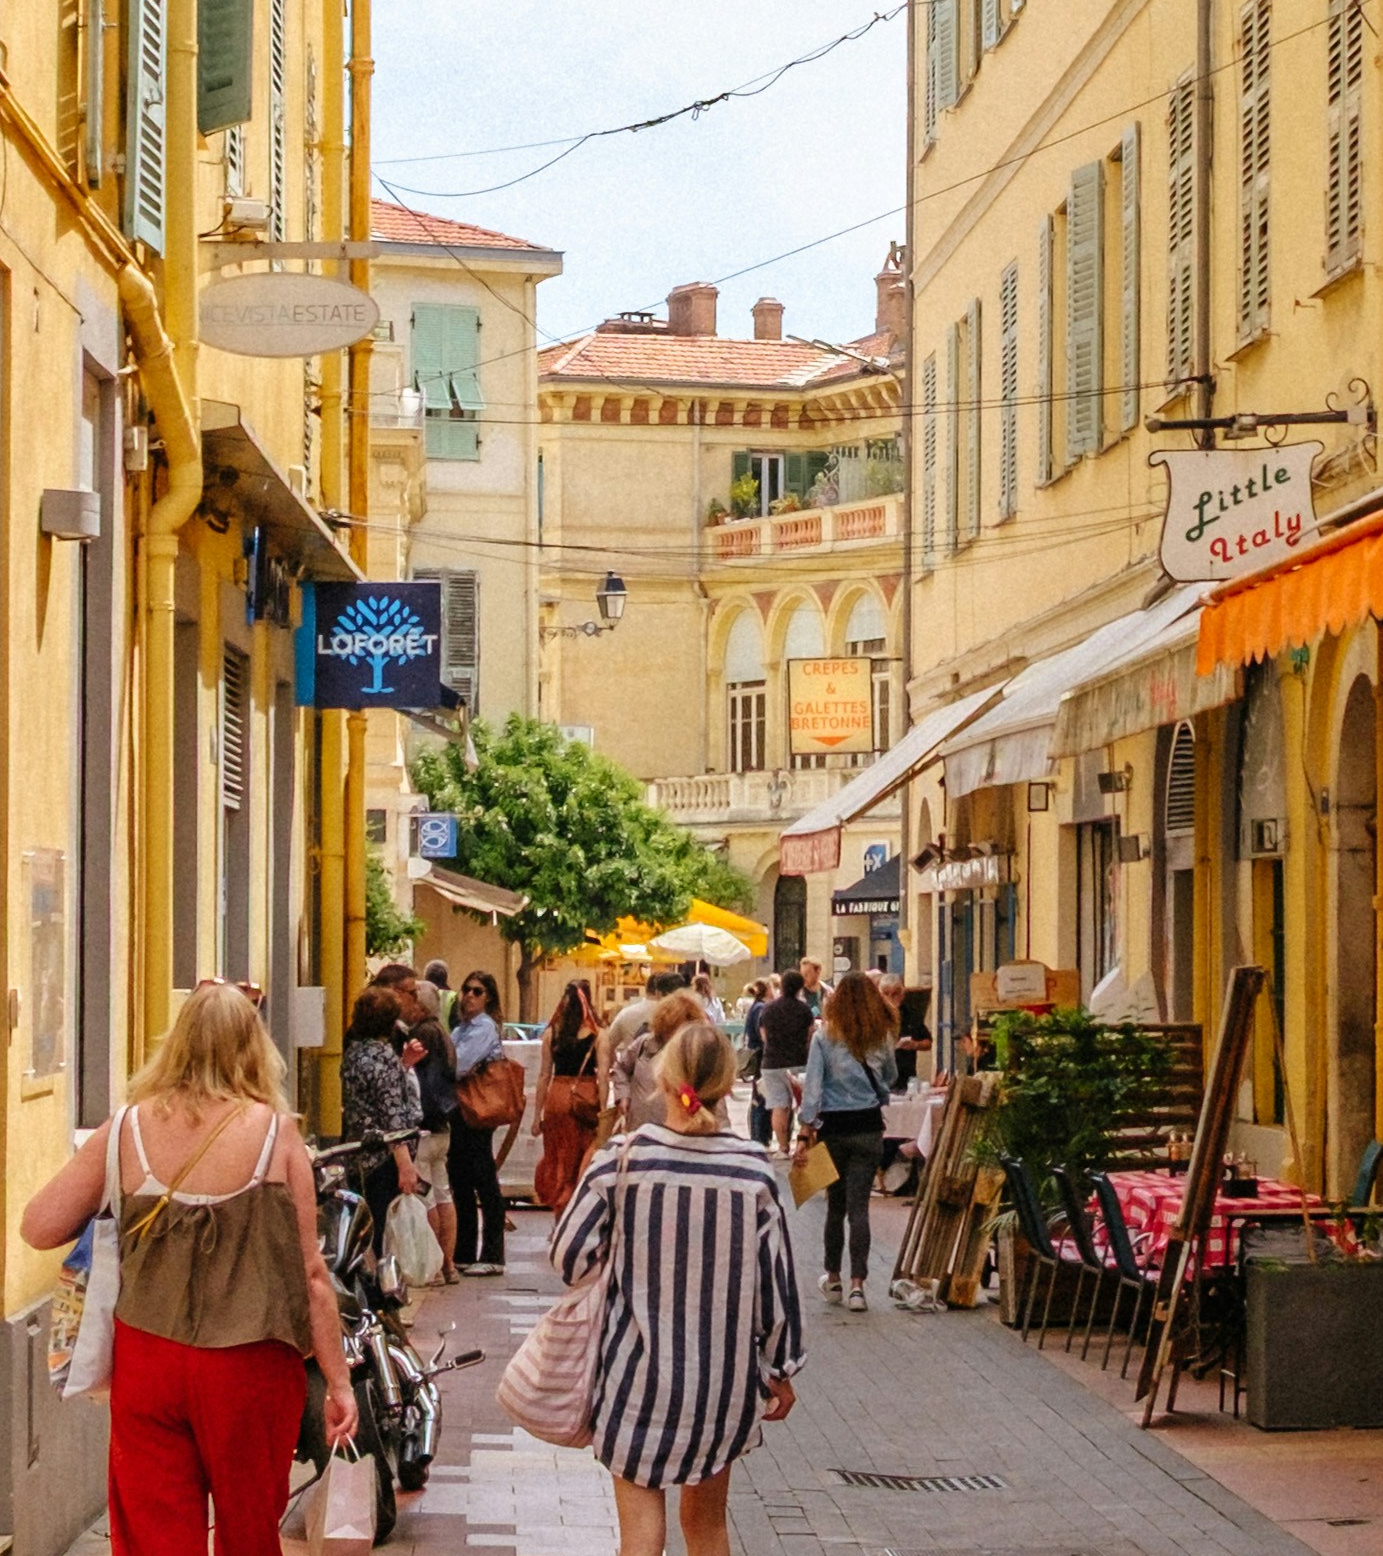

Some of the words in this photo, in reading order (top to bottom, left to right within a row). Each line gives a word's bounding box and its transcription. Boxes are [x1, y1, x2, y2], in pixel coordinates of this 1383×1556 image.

[1185, 464, 1291, 542] Little
[1209, 510, 1301, 563] Italy
[826, 682, 836, 695] &
[794, 701, 867, 715] GALETTES
[790, 716, 870, 730] BRETONNE
[836, 903, 846, 914] LA
